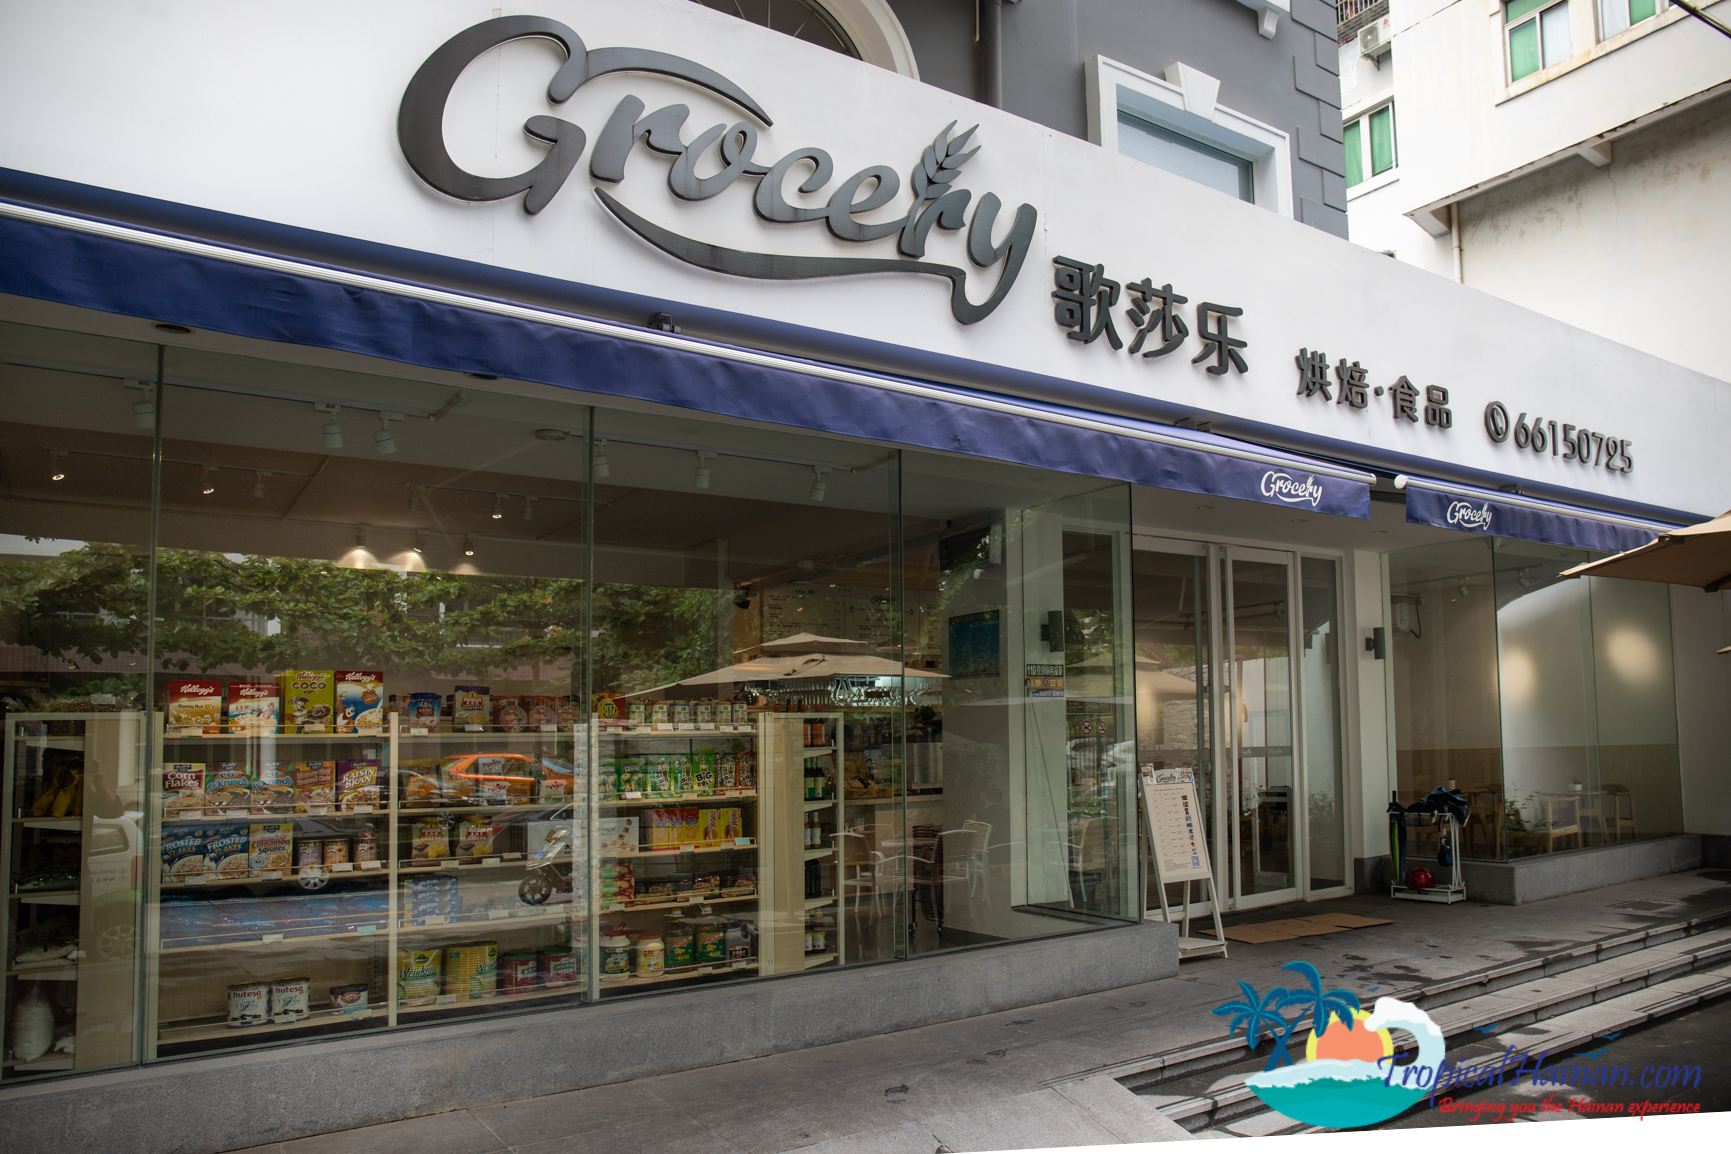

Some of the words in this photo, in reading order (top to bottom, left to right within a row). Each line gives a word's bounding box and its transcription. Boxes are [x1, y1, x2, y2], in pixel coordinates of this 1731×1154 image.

[399, 14, 1038, 326] Grocery
[1051, 254, 1249, 376] 歌莎乐
[1514, 411, 1634, 474] 66150725
[1260, 470, 1323, 507] Grocery
[1447, 500, 1492, 531] Grocery
[345, 671, 376, 682] Kellogg's
[180, 684, 215, 696] Kellogg's
[292, 681, 327, 690] COCO
[239, 687, 269, 698] Kellogg's
[178, 703, 194, 711] Honey
[602, 705, 617, 715] RITZ
[167, 771, 196, 780] Corn
[342, 768, 376, 784] RAISIN
[165, 779, 200, 789] Flakes
[345, 775, 373, 790] BRAN
[161, 838, 202, 852] FROSTED
[207, 836, 247, 850] FROSTED
[251, 839, 290, 849] Cinnamon
[168, 845, 196, 859] FLAKES
[214, 844, 243, 857] FLAKES
[258, 845, 286, 854] Squares
[233, 990, 262, 999] hutesa
[275, 985, 303, 994] hutesa
